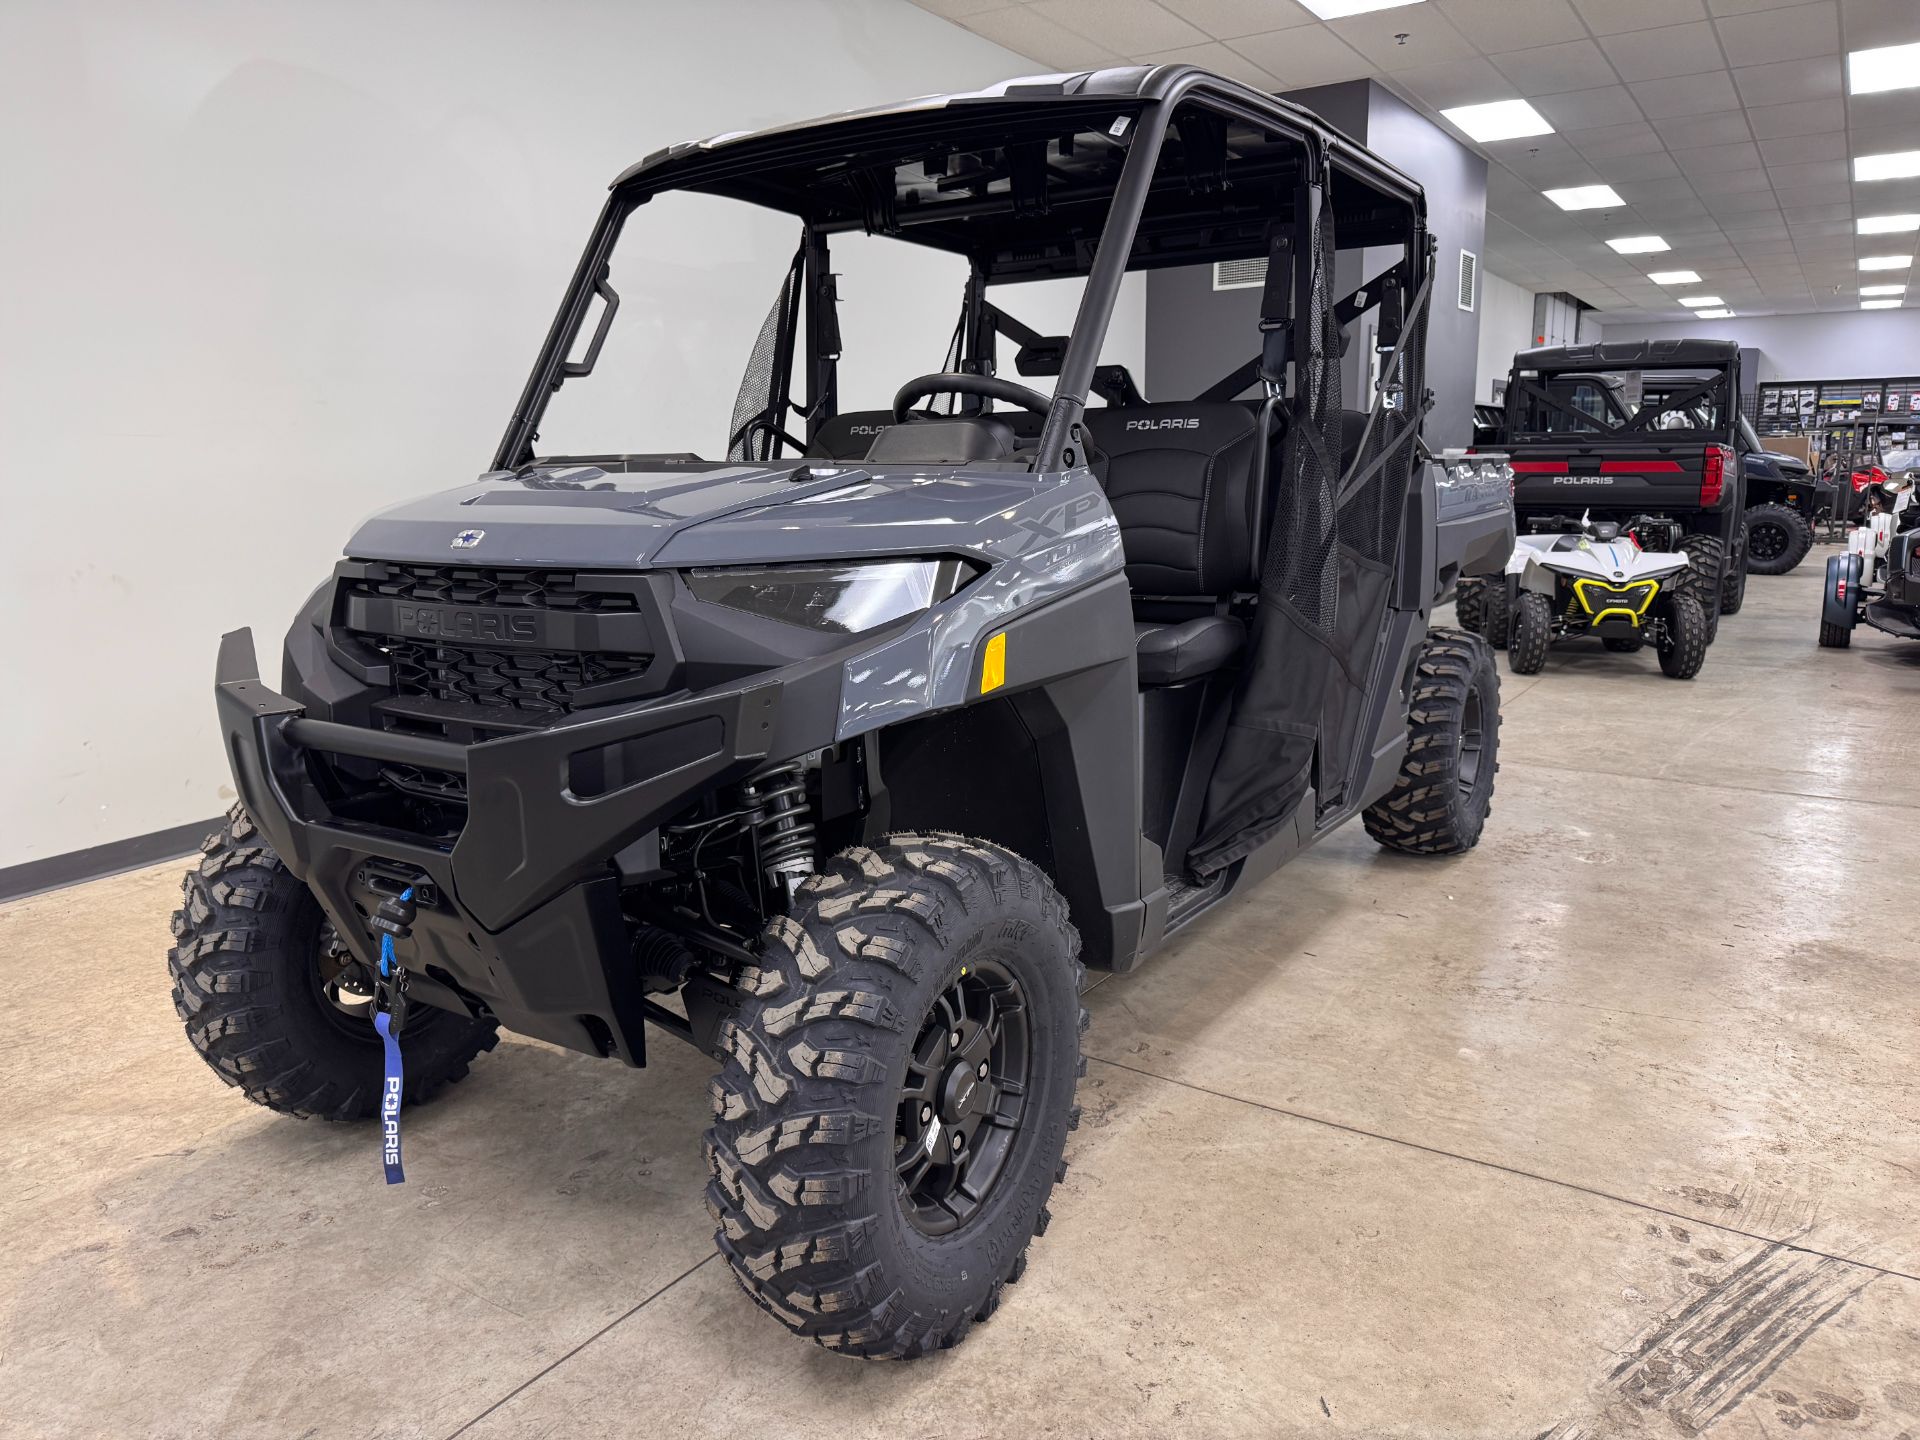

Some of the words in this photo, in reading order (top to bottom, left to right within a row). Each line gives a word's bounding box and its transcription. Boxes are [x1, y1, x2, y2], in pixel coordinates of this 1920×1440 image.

[850, 425, 887, 435] POLA
[1126, 418, 1200, 431] POLARIS
[1553, 476, 1614, 485] POLARIS
[1014, 492, 1102, 555] XP
[398, 605, 537, 643] POLARIS
[383, 1077, 400, 1165] POLARIS
